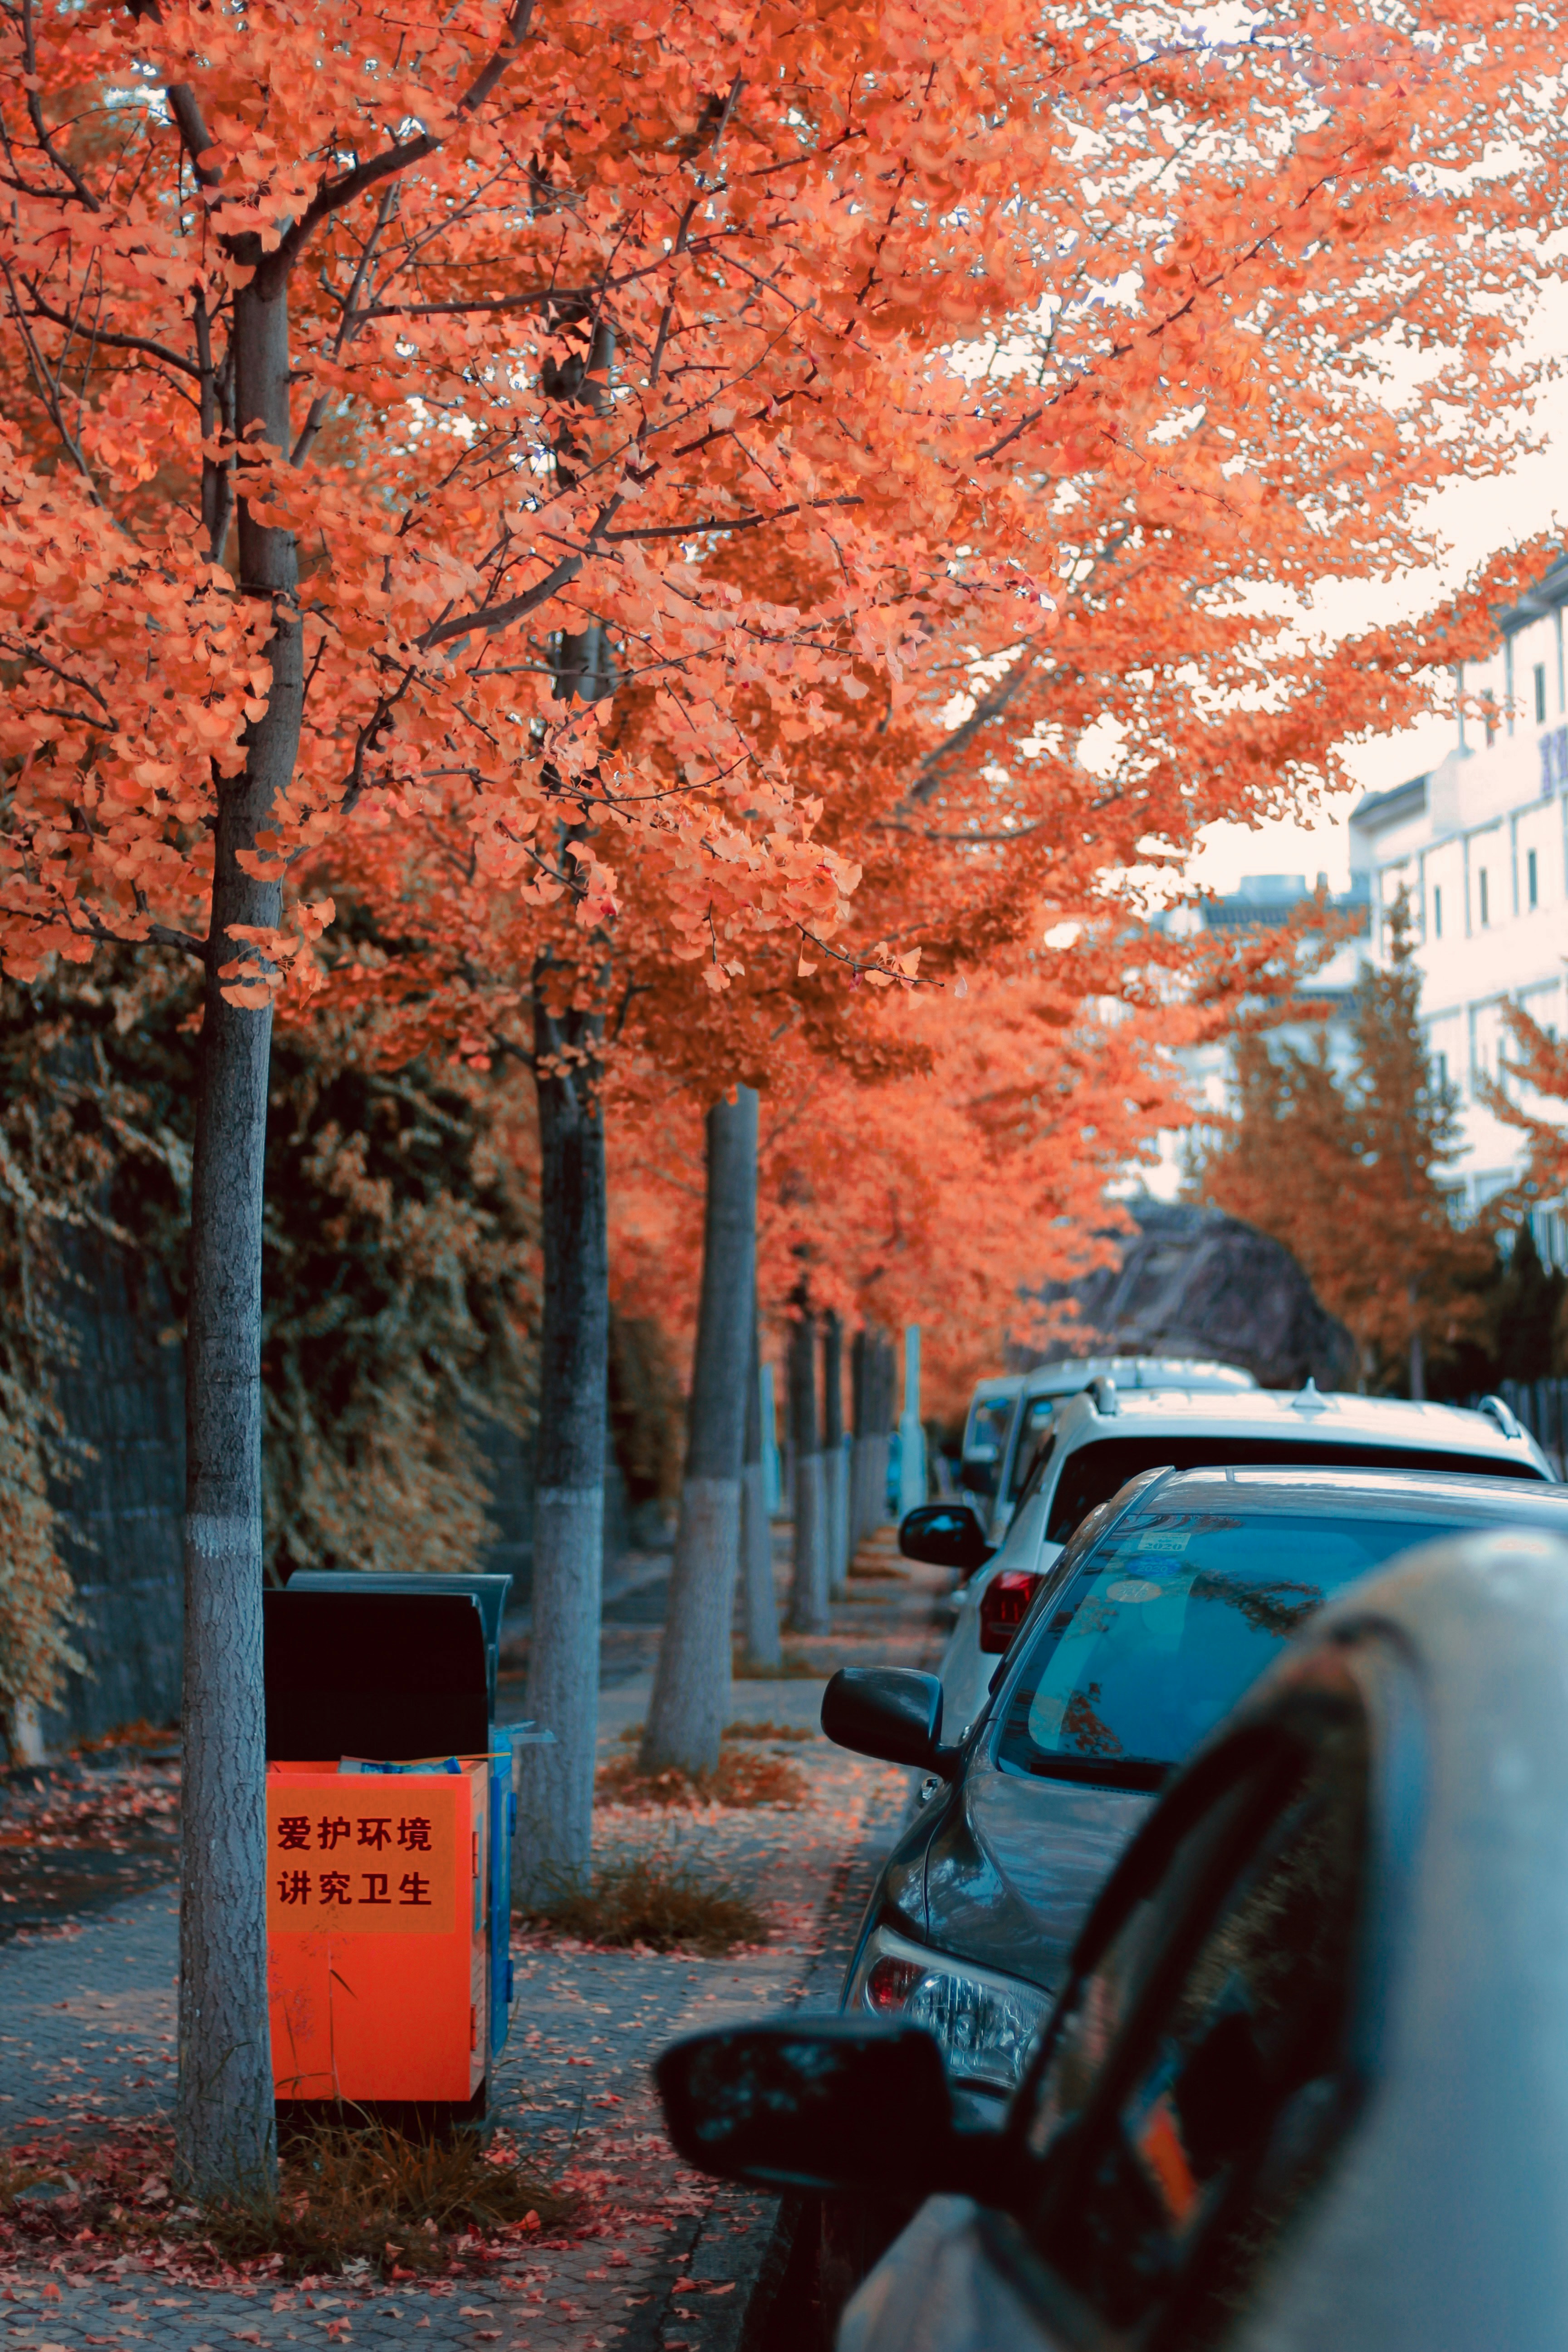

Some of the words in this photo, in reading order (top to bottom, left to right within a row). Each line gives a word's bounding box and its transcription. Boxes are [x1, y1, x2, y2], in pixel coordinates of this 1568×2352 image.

[278, 1816, 432, 1851] 爱护环境
[277, 1870, 431, 1905] 讲究卫生
